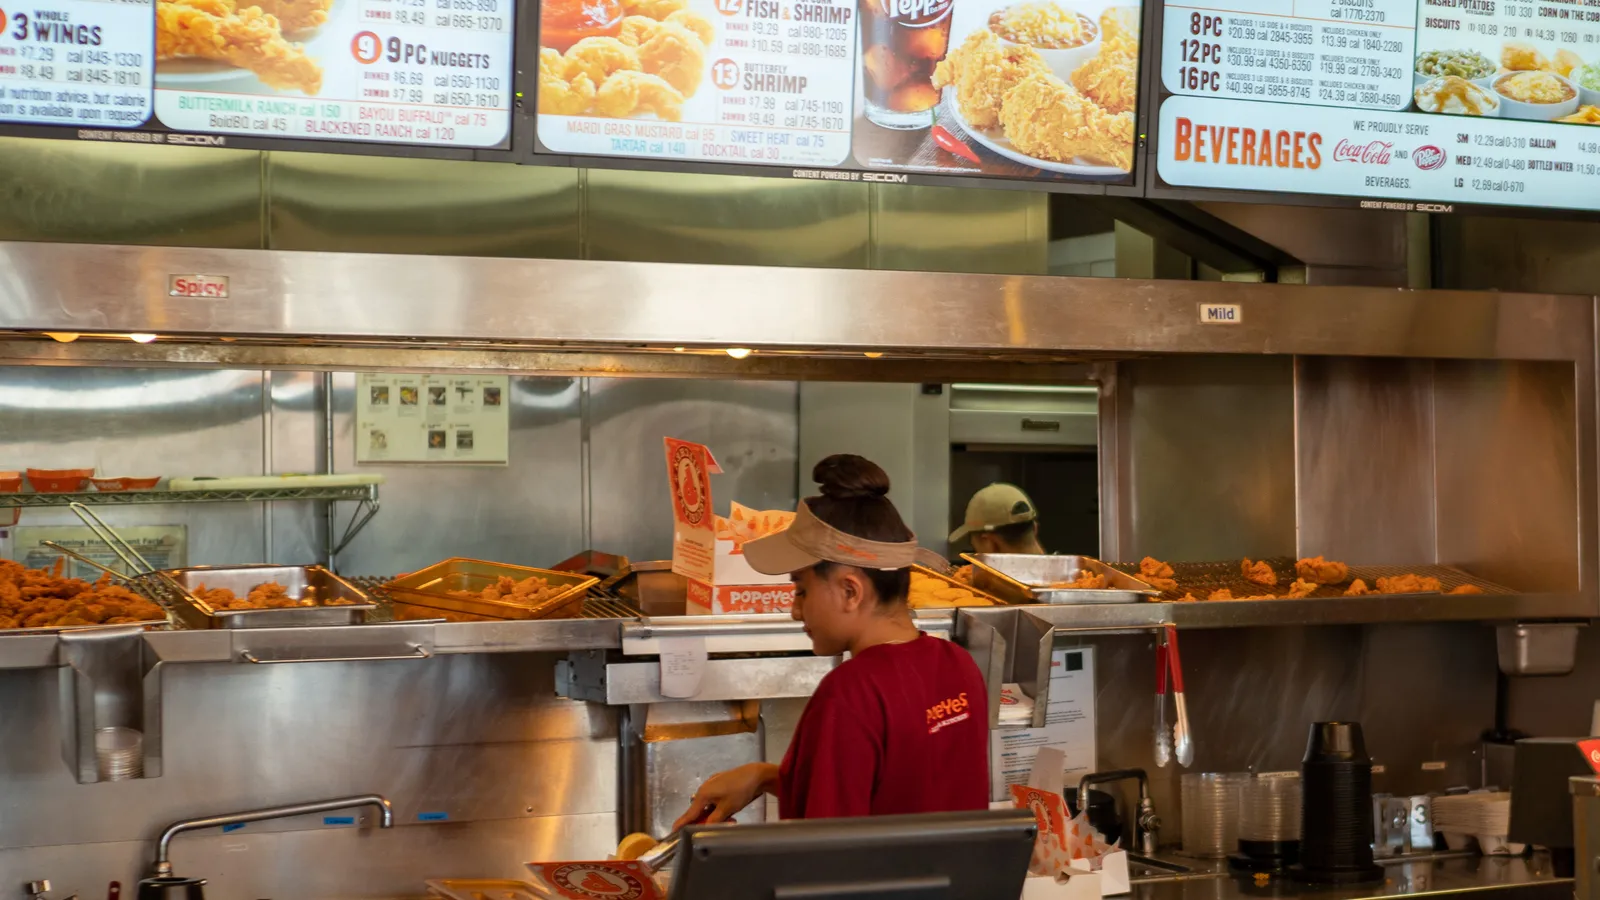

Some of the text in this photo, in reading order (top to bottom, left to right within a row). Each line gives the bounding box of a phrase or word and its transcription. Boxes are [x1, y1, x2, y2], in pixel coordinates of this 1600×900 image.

[746, 0, 851, 25] FISH & SHRIMP
[1459, 0, 1495, 12] POTATOES
[1504, 5, 1533, 18] 110 330
[1538, 6, 1600, 22] CORN ON THE COB
[34, 10, 69, 21] WHOLE
[365, 10, 502, 31] COMBO $8.49 cal 665-1370
[1330, 8, 1385, 22] cal 1770-2370
[12, 12, 102, 46] 3 WINGS
[752, 22, 779, 36] $9.29
[788, 26, 801, 38] cal
[803, 26, 847, 41] 980-1205
[1228, 27, 1313, 45] $20.99 cal 2845-3955
[1425, 17, 1460, 31] BISCUITS
[1503, 26, 1517, 38] 210
[357, 34, 375, 60] 9
[431, 51, 490, 69] NUGGETS
[725, 39, 847, 58] COMBO $10.59 cal 980-1685
[1321, 35, 1403, 53] $13.99 cal 1840-2280
[67, 51, 82, 63] cal
[1227, 54, 1312, 71] $30.99 cal 4350-6350
[67, 70, 82, 82] cal
[744, 62, 788, 74] BUTTERFLY
[1320, 62, 1401, 79] $19.99 cal 2760-3420
[434, 75, 449, 87] cal
[451, 75, 499, 90] 650-1130
[714, 63, 807, 94] 13 SHRIMP
[10, 88, 52, 101] nutrition
[94, 94, 110, 105] but
[113, 95, 146, 107] calorie
[1226, 81, 1310, 98] $40.99 cal 5855-8745
[1347, 91, 1357, 102] cal
[1360, 91, 1400, 105] 3680-4560
[178, 96, 340, 118] BUTTERMILK RANCH cal 150
[363, 89, 499, 108] COMBO $7.99 cal 650-1610
[748, 96, 776, 111] $7.99
[785, 100, 798, 112] cal
[801, 100, 843, 114] 745-1190
[18, 105, 26, 115] is
[29, 103, 74, 117] available
[77, 108, 101, 120] upon
[360, 106, 394, 121] BAYOU
[455, 114, 469, 126] cal
[474, 113, 487, 127] 75
[253, 118, 287, 131] cal 45
[722, 112, 843, 130] COMBO $9.49 cal 745-1670
[1353, 120, 1429, 136] WE PROUDLY SERVE
[78, 129, 112, 139] CONTENT
[114, 131, 150, 142] POWERED
[306, 120, 455, 140] BLACKENED RANCH cal 120
[566, 120, 600, 134] MARDI
[604, 122, 632, 137] GRAS
[635, 124, 682, 140] MUSTARD
[685, 128, 699, 140] cal
[611, 138, 685, 155] TARTAR cal 140
[731, 130, 764, 145] SWEET
[796, 134, 810, 147] cal
[813, 135, 825, 148] 75
[1174, 116, 1322, 170] BEVERAGES
[1456, 133, 1469, 144] SM
[1529, 138, 1556, 149] GALLON
[702, 144, 747, 159] COCKTAIL
[751, 148, 765, 160] cal
[768, 148, 780, 161] 30
[1394, 149, 1408, 159] AND
[1455, 155, 1471, 166] MED
[1528, 160, 1553, 171] BOTTLED
[1554, 161, 1573, 172] WATER
[793, 170, 908, 183] CONTENT POWERED SICOM
[1365, 175, 1411, 189] BEVERAGES.
[1454, 177, 1464, 188] LG
[1360, 201, 1453, 212] CONTENT POWERED SICOM
[175, 278, 225, 297] Spicy
[1207, 307, 1235, 320] Mild
[1414, 803, 1428, 824] 3
